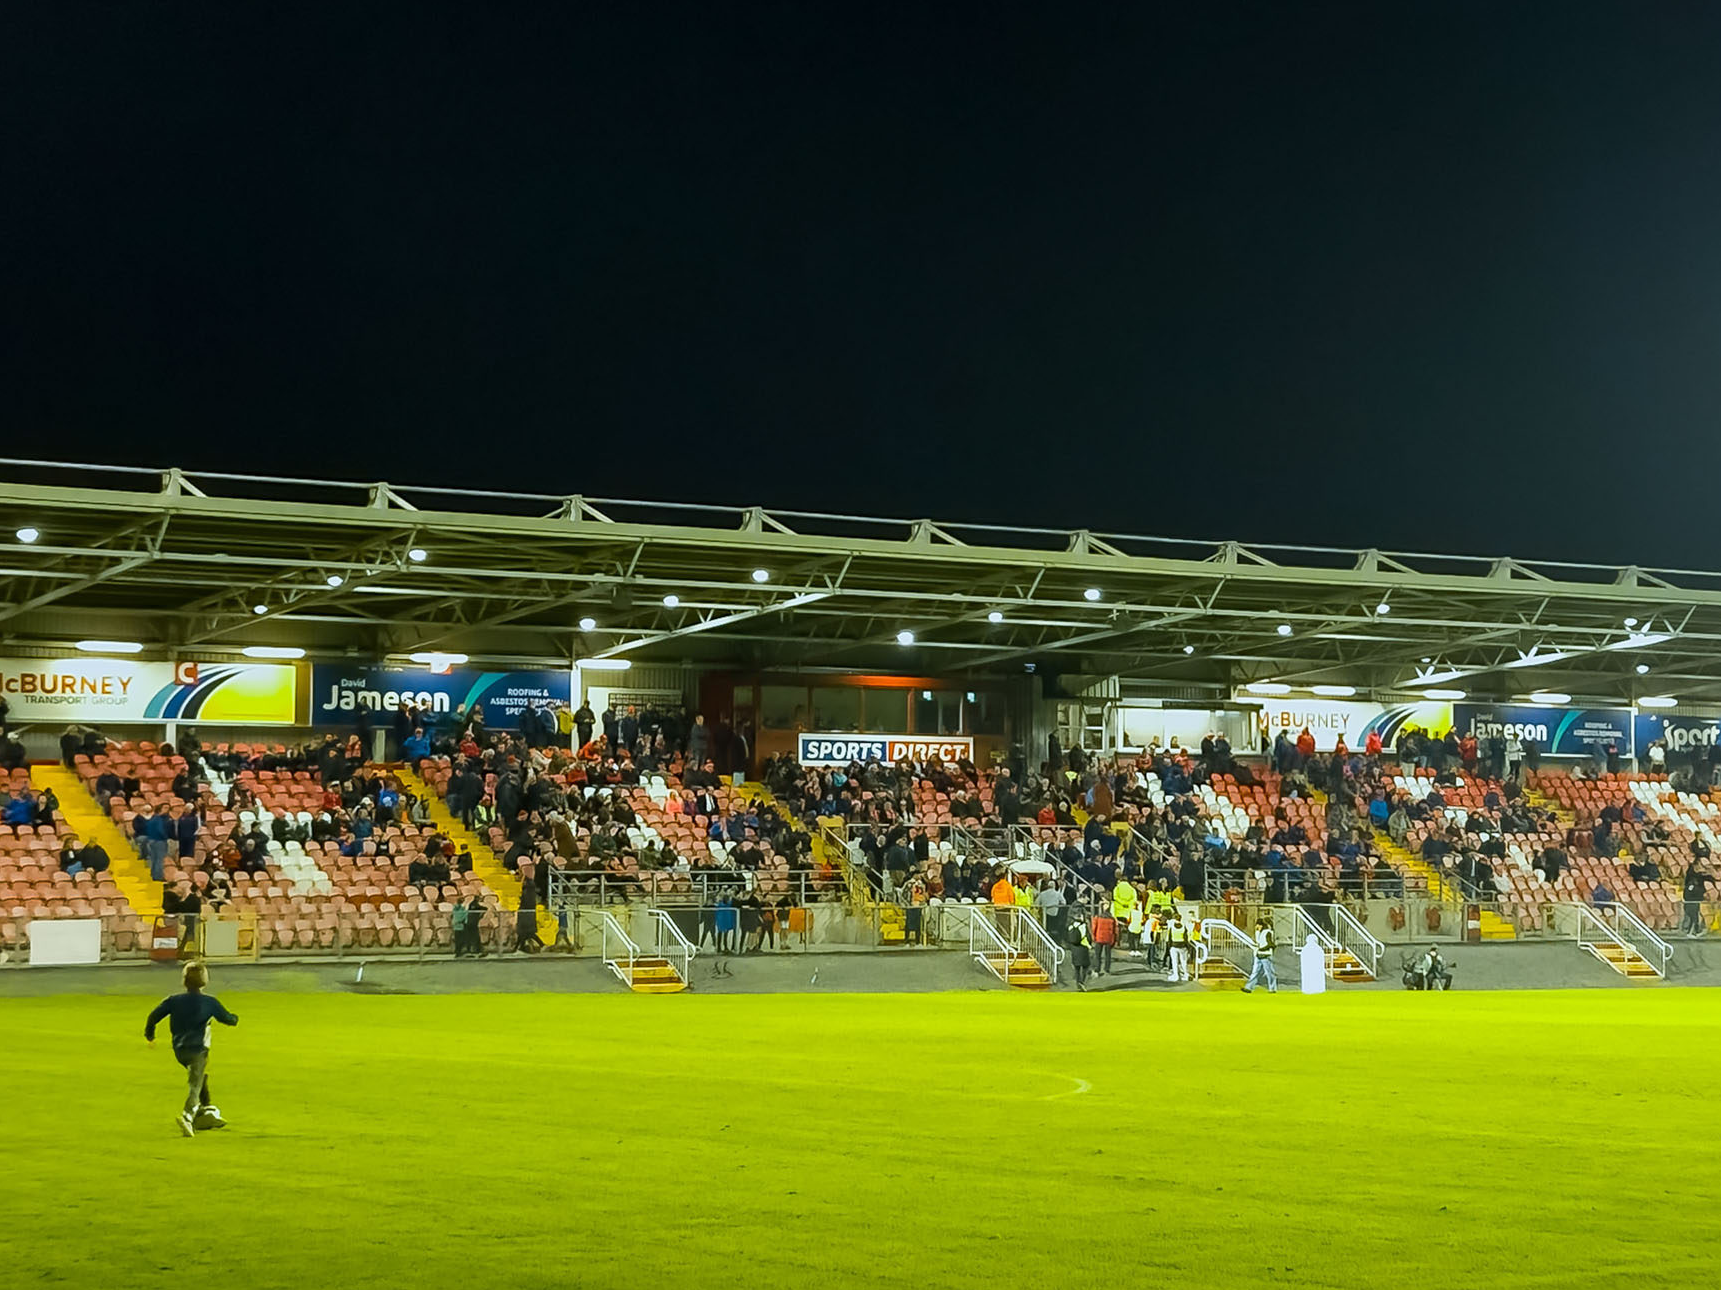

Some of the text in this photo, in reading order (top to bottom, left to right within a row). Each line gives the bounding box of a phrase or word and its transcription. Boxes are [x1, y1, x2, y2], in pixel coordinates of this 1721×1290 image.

[178, 662, 196, 684] C
[341, 678, 366, 688] David
[23, 694, 128, 706] TRANSPORT GROUP
[322, 684, 450, 713] Jameson
[507, 688, 541, 697] ROOFING
[1259, 711, 1350, 729] McBURNEY
[806, 741, 883, 760] SPORTS
